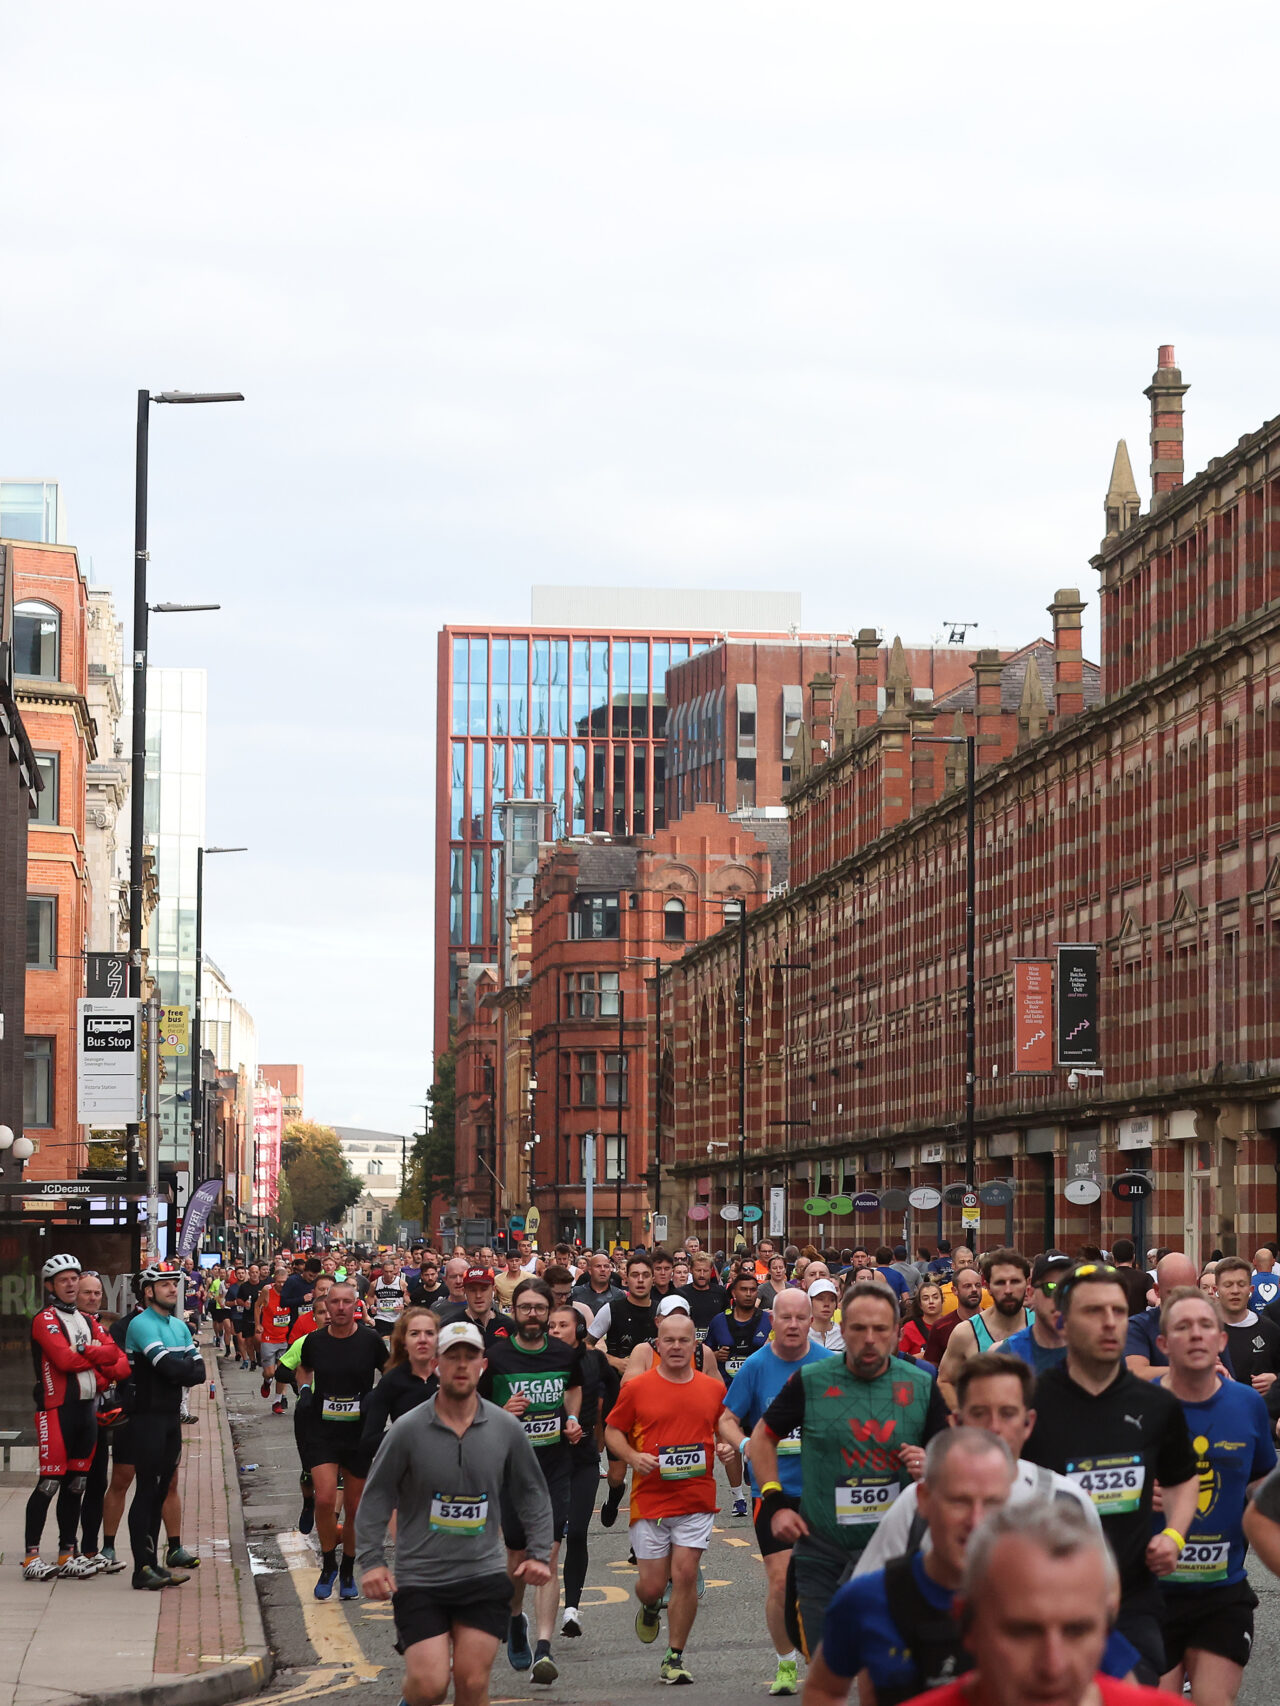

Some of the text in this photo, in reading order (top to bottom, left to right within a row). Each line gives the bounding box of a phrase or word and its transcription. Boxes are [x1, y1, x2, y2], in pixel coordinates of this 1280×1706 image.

[87, 1036, 131, 1049] Bus Stop
[42, 1184, 90, 1194] JCDecaux
[1130, 1186, 1143, 1194] JLL
[183, 1210, 201, 1249] SPORTS FEET
[509, 1379, 563, 1394] VEGAN
[328, 1402, 354, 1411] 4917
[524, 1421, 556, 1433] 4672
[665, 1453, 700, 1466] 4670
[1080, 1470, 1136, 1490] 4326
[851, 1489, 889, 1504] 560
[440, 1504, 481, 1519] 5341
[1178, 1546, 1224, 1562] 207
